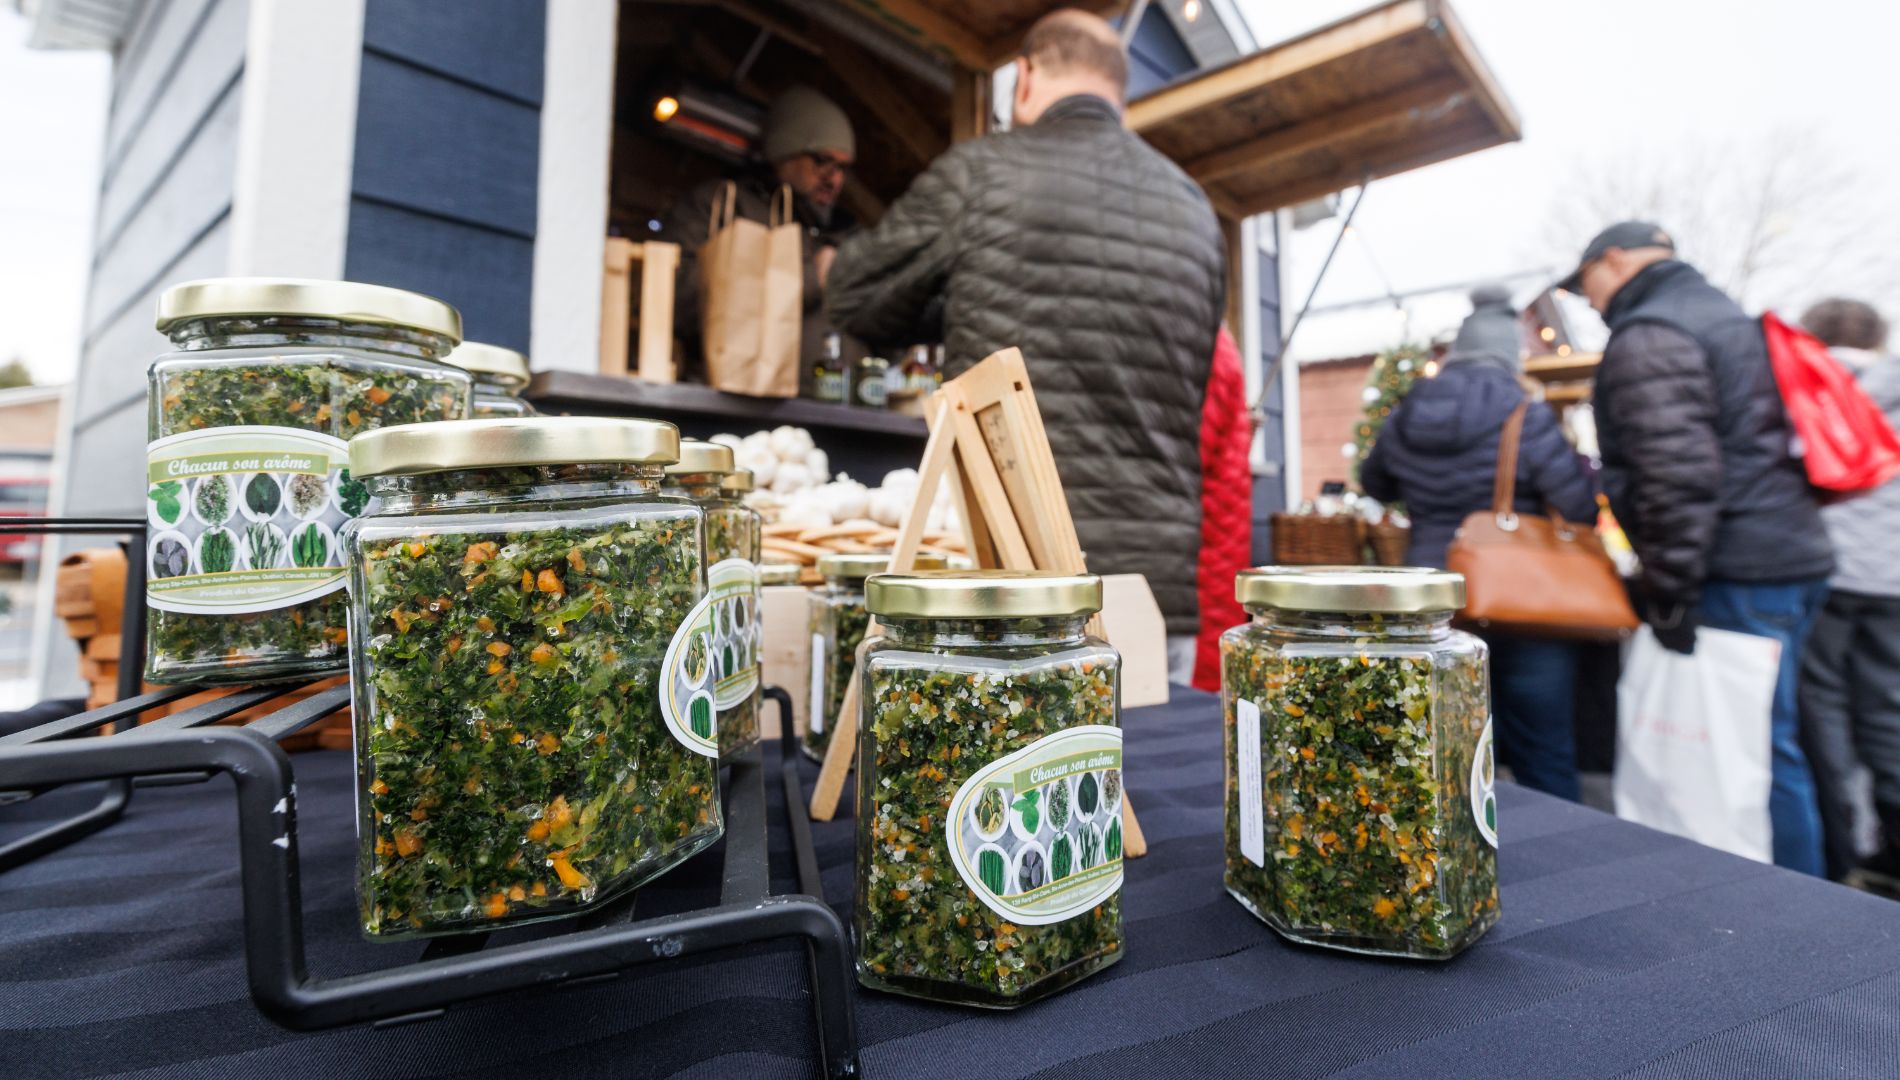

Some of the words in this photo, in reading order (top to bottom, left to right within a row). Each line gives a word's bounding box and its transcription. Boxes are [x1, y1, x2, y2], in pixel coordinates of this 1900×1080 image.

[168, 459, 228, 476] Chacun
[233, 458, 260, 470] son
[263, 455, 312, 470] arôme
[1030, 764, 1068, 784] Chacun
[1070, 759, 1086, 772] son
[1088, 752, 1114, 769] arôme
